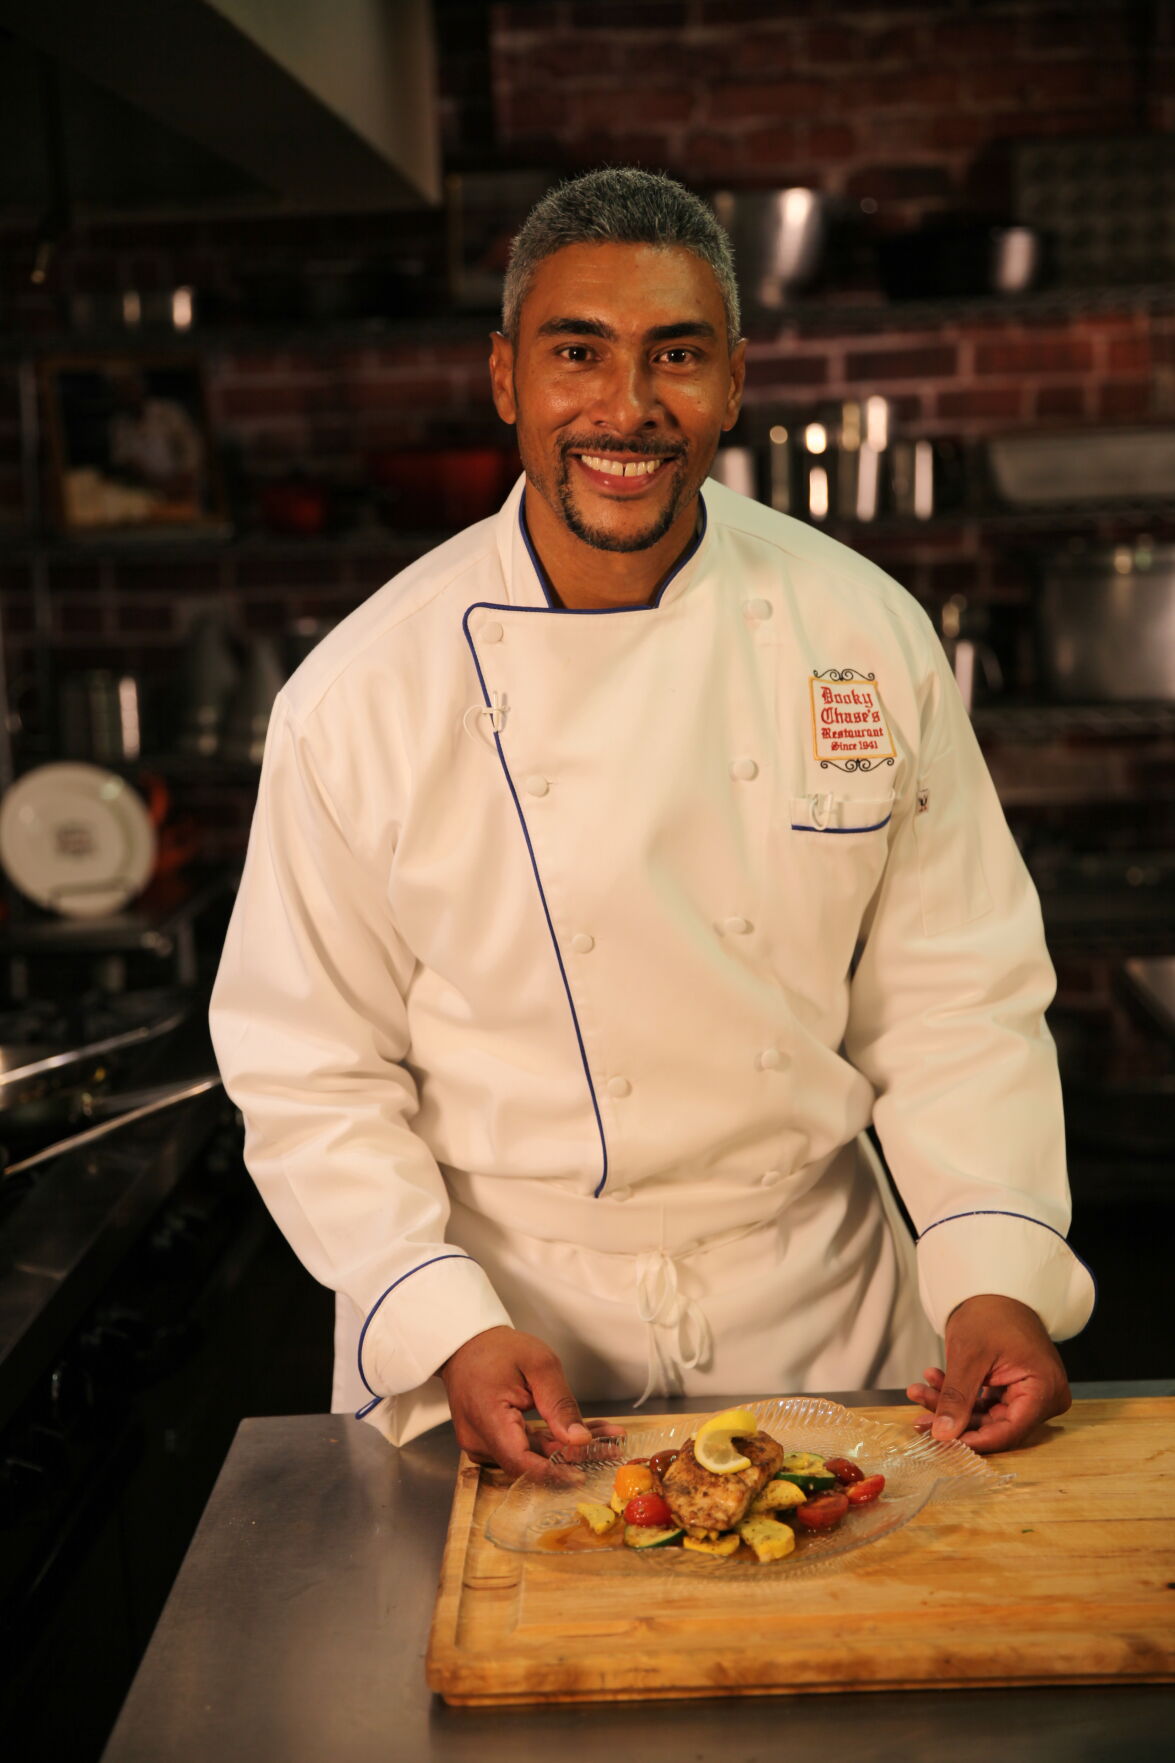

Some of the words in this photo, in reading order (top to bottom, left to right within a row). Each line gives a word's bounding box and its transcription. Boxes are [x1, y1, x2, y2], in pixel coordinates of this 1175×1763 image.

[820, 707, 881, 724] Chase's
[821, 727, 884, 739] Restaurant
[831, 742, 857, 751] Since
[859, 740, 878, 750] 1941
